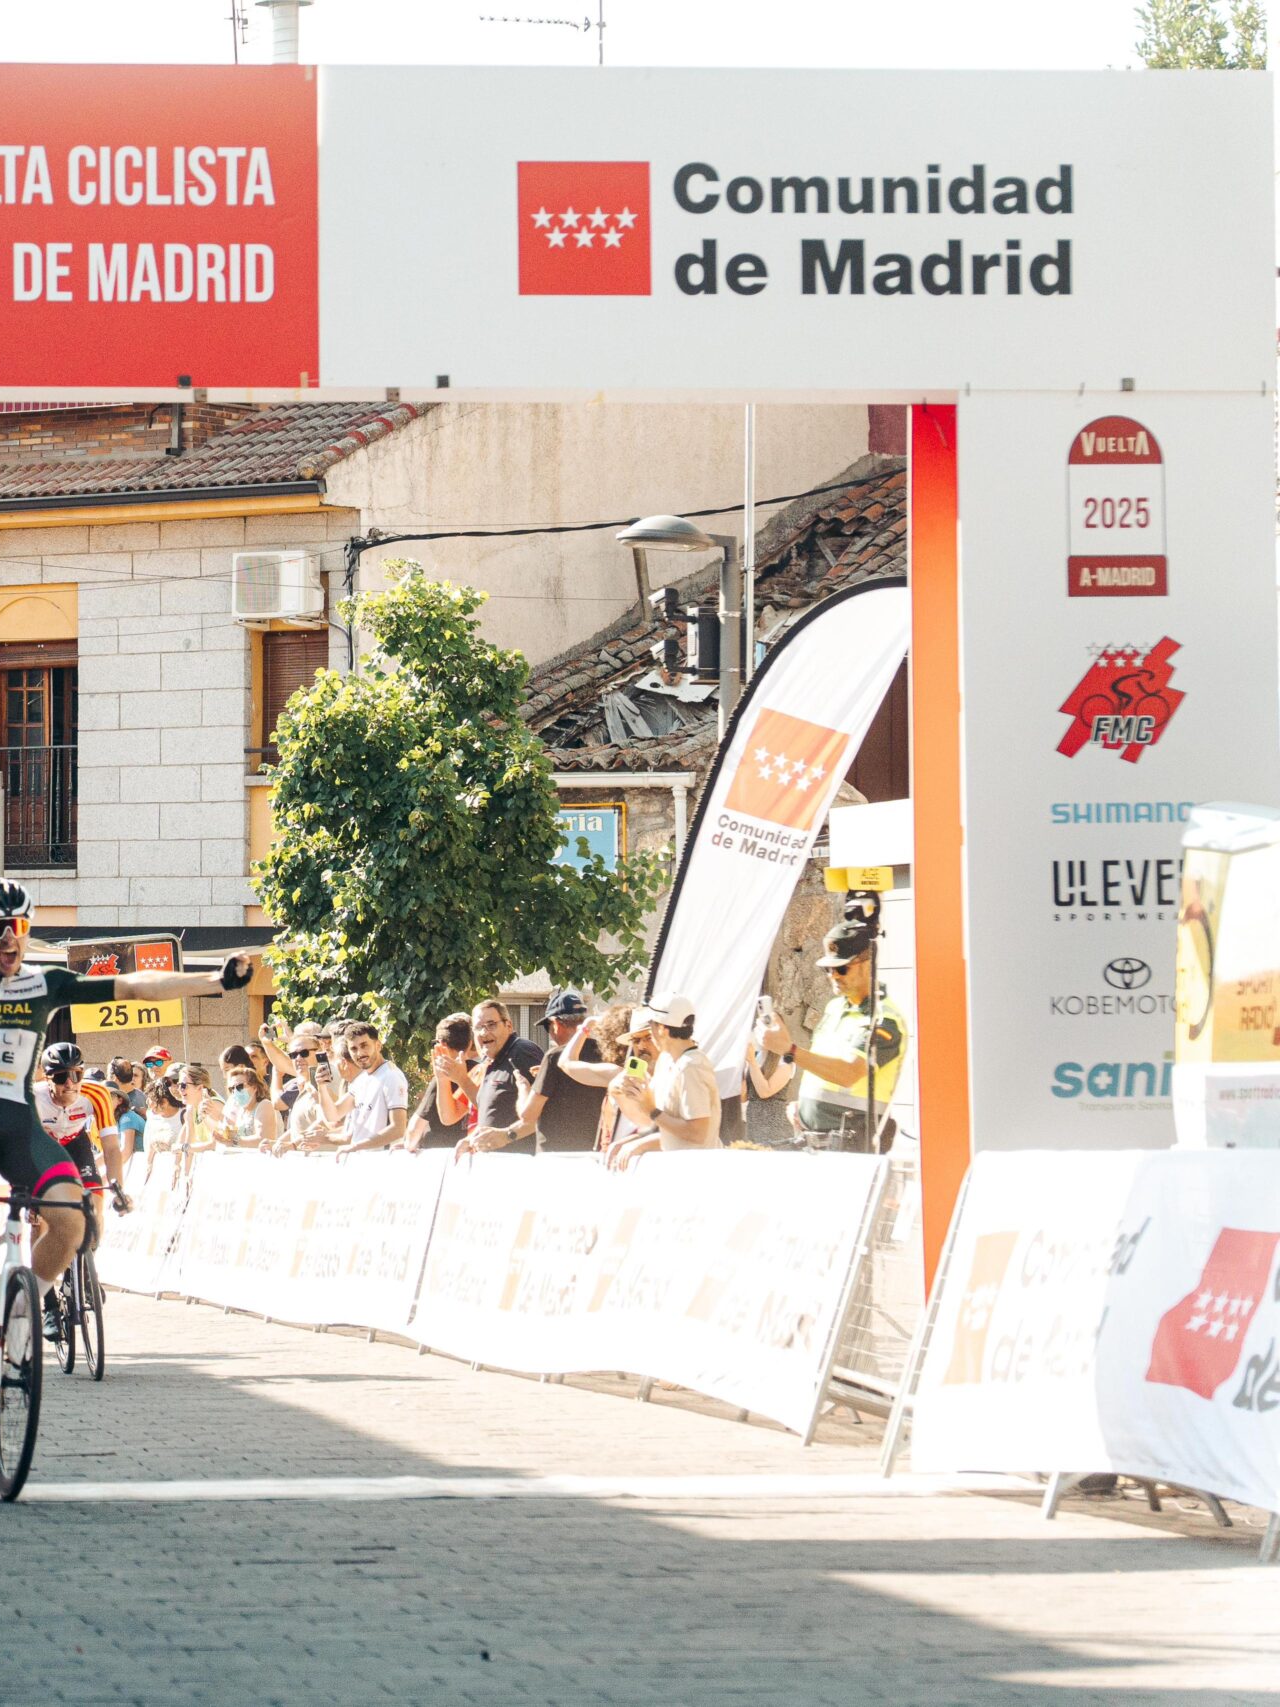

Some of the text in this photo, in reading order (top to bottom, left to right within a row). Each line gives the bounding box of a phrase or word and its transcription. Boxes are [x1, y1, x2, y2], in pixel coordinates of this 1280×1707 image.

[68, 145, 276, 206] CICLISTA
[673, 162, 1074, 214] Comunidad
[13, 242, 73, 302] DE
[88, 243, 275, 303] MADRID
[674, 238, 1073, 297] de Madrid
[1080, 431, 1149, 456] VUELTA
[1083, 497, 1151, 528] 2025
[1079, 567, 1156, 587] A-MADRID
[1091, 715, 1155, 744] FMC
[711, 831, 734, 849] de
[718, 814, 808, 849] Comunidad
[1053, 913, 1179, 922] SPORTWE
[99, 1005, 160, 1027] 25 m
[1050, 995, 1177, 1015] KOBEMOT
[1051, 1051, 1175, 1098] sani
